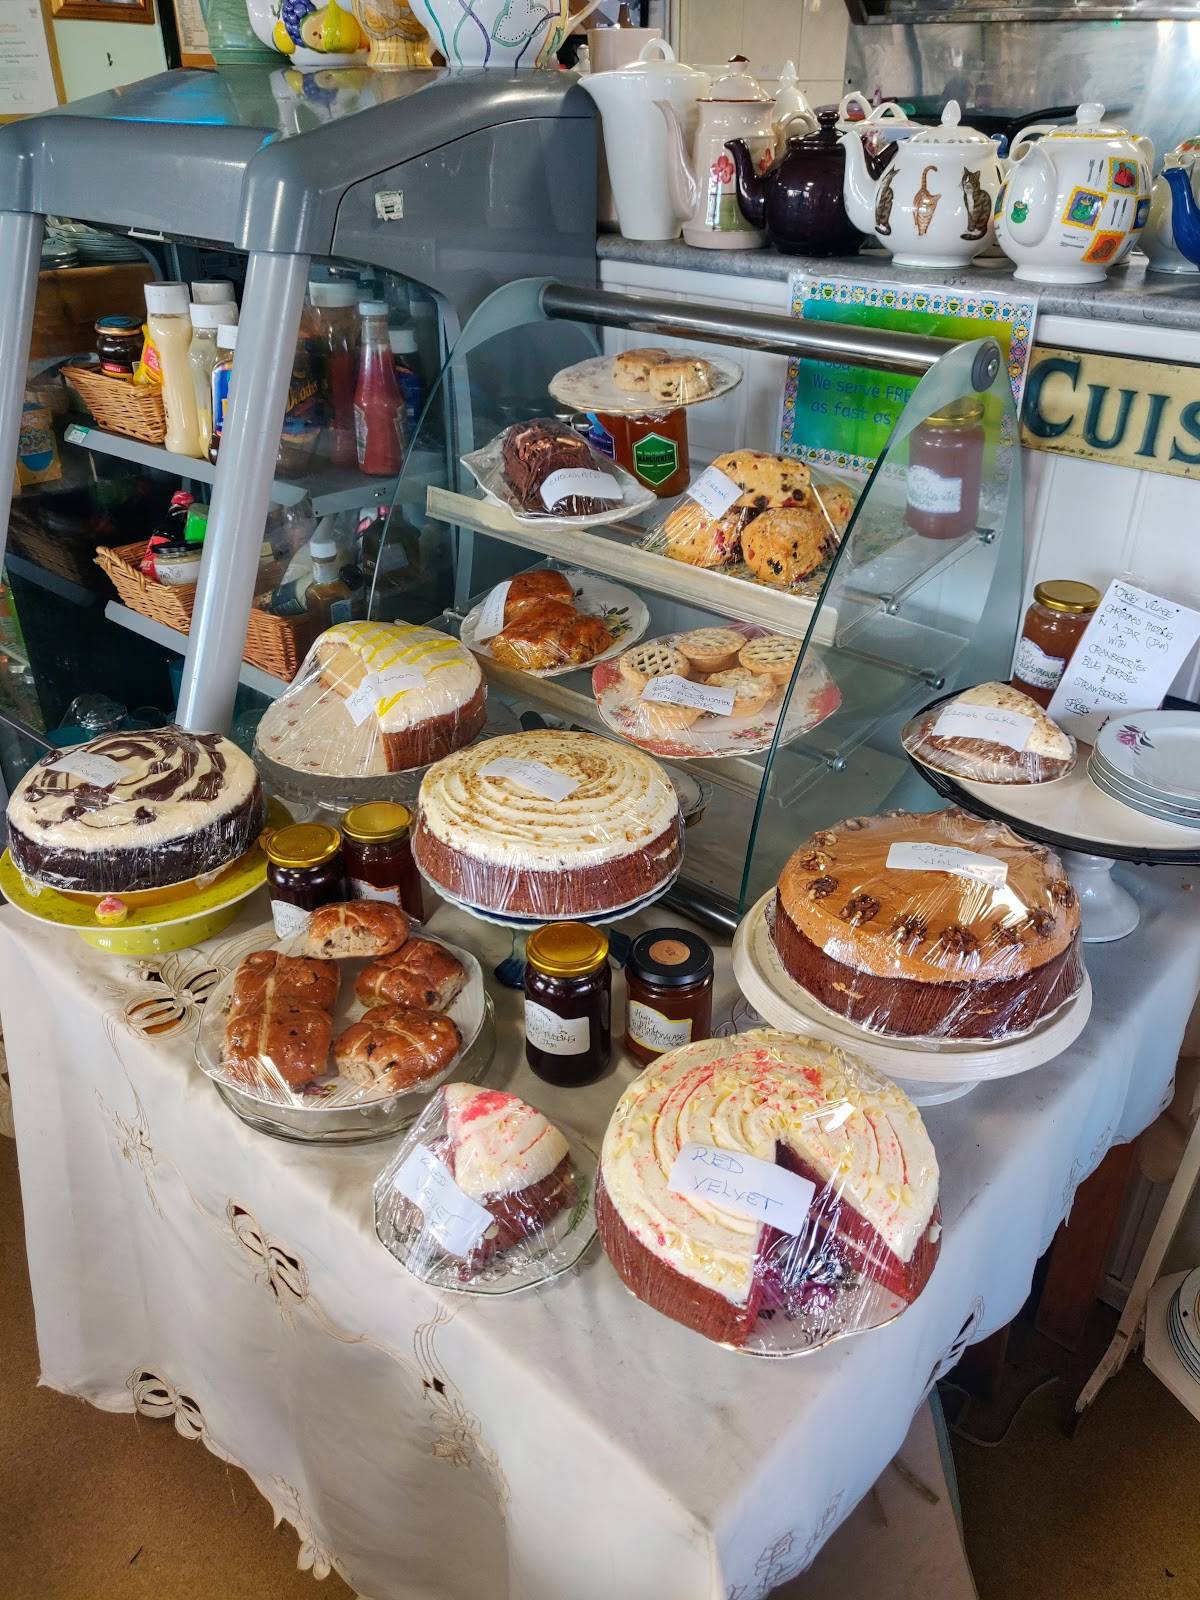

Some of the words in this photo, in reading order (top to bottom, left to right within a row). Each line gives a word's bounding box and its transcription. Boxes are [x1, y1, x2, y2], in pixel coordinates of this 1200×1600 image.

[813, 373, 831, 390] We
[837, 380, 880, 397] serve
[886, 385, 913, 403] FRE
[810, 401, 828, 414] as
[834, 401, 868, 420] fast
[873, 412, 891, 425] as
[1022, 358, 1200, 464] CUIS
[1112, 622, 1120, 631] A
[692, 1147, 744, 1174] RED
